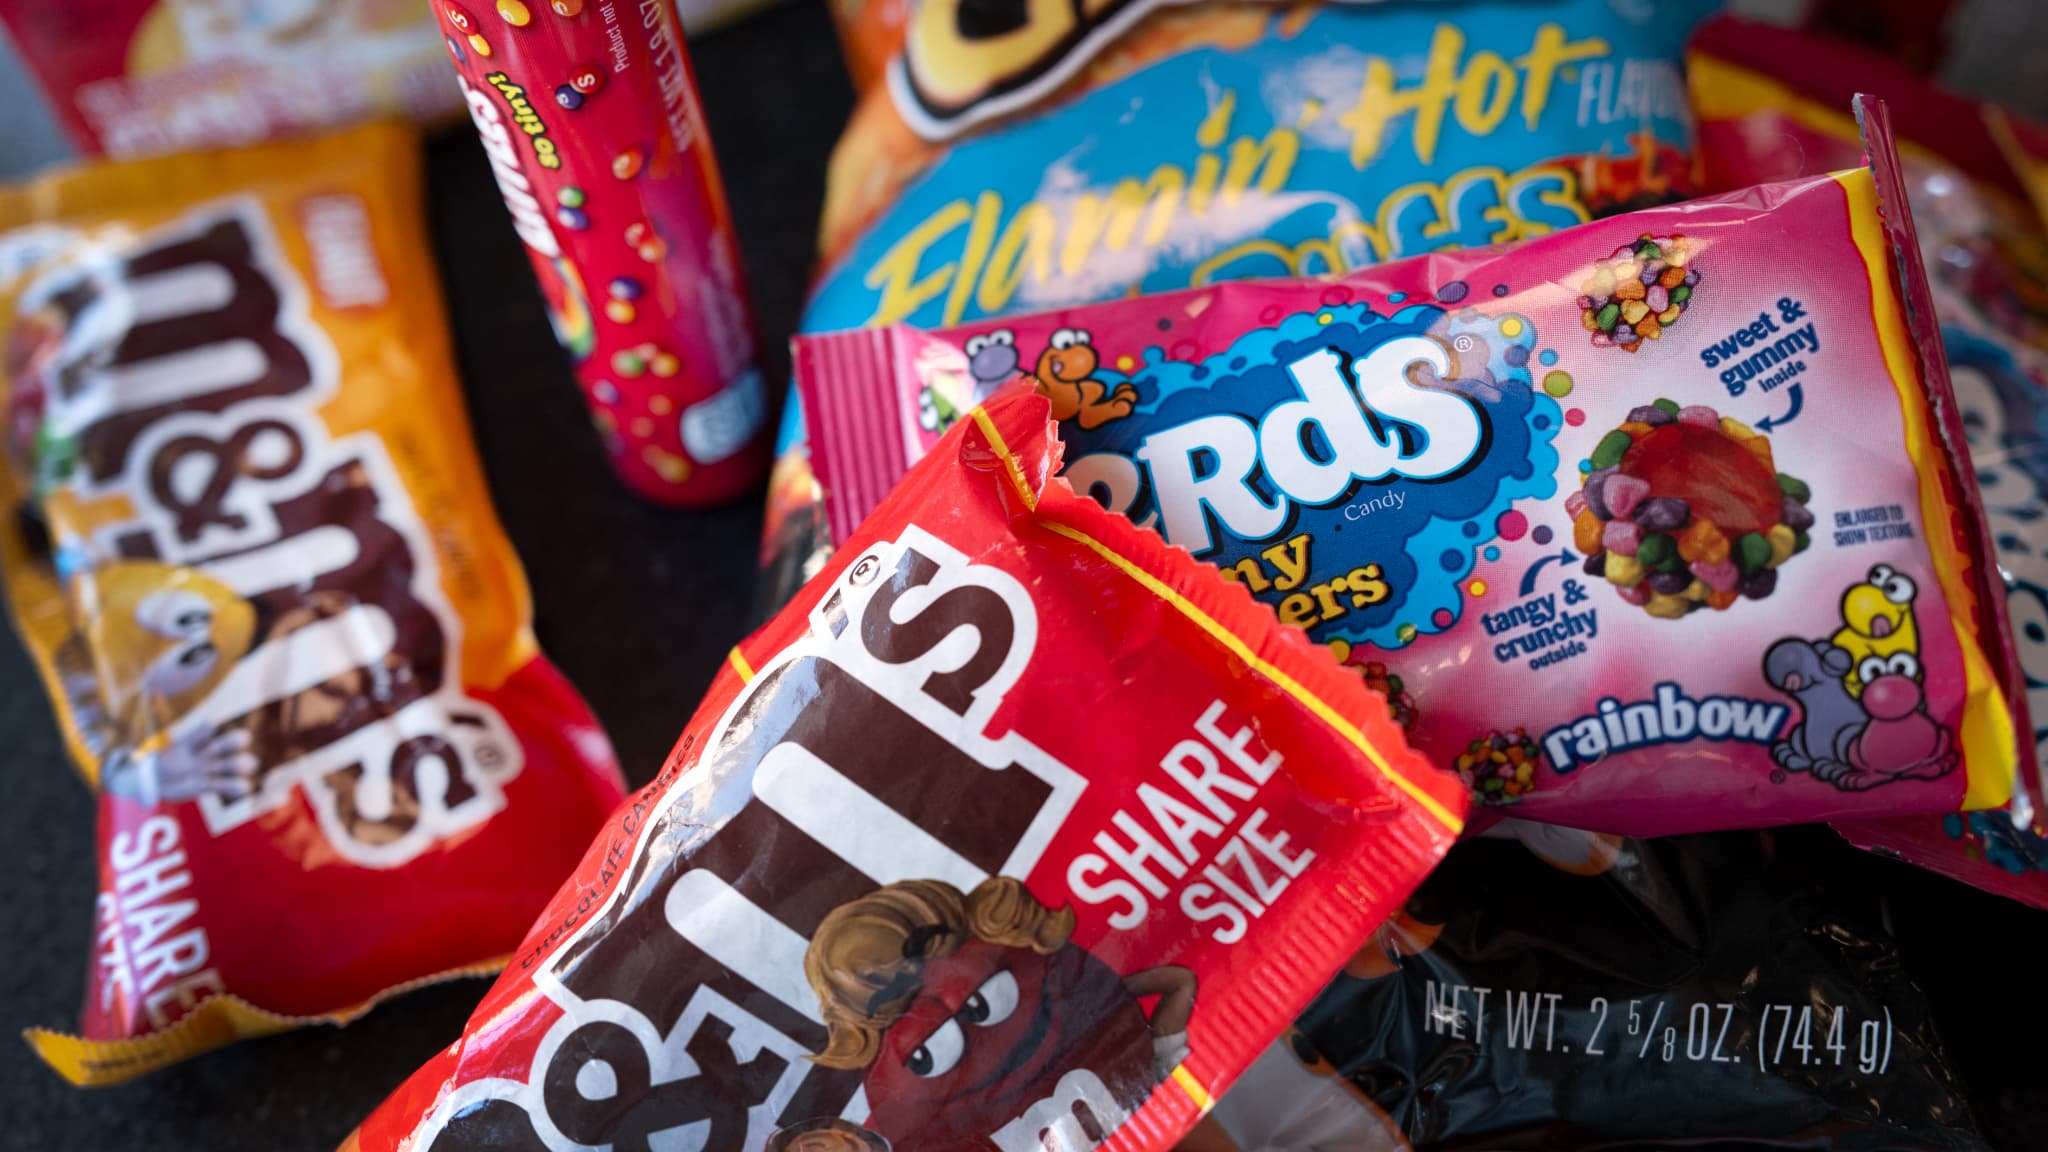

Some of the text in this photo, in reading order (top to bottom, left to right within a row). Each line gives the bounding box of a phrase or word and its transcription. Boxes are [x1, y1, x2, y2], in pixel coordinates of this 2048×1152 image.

[606, 24, 630, 73] Product
[486, 71, 546, 137] tiny!
[1338, 22, 1612, 171] Hot
[1700, 297, 1807, 369] sweet &
[1720, 323, 1820, 397] gummy
[1758, 360, 1807, 393] inside
[1343, 488, 1406, 523] Candy
[1480, 578, 1590, 637] tangy &
[1493, 607, 1598, 663] crunchy
[1529, 640, 1588, 671] outside
[1542, 682, 1790, 773] rainbow
[1066, 698, 1286, 931] SHARE
[1179, 807, 1318, 944] SIZE
[1424, 979, 1492, 1045] NET
[1505, 989, 1569, 1054] WT.
[1585, 997, 1608, 1056] 2
[1686, 1002, 1741, 1063] OZ.
[1757, 1003, 1847, 1073] (74.4
[1859, 1005, 1893, 1075] g)
